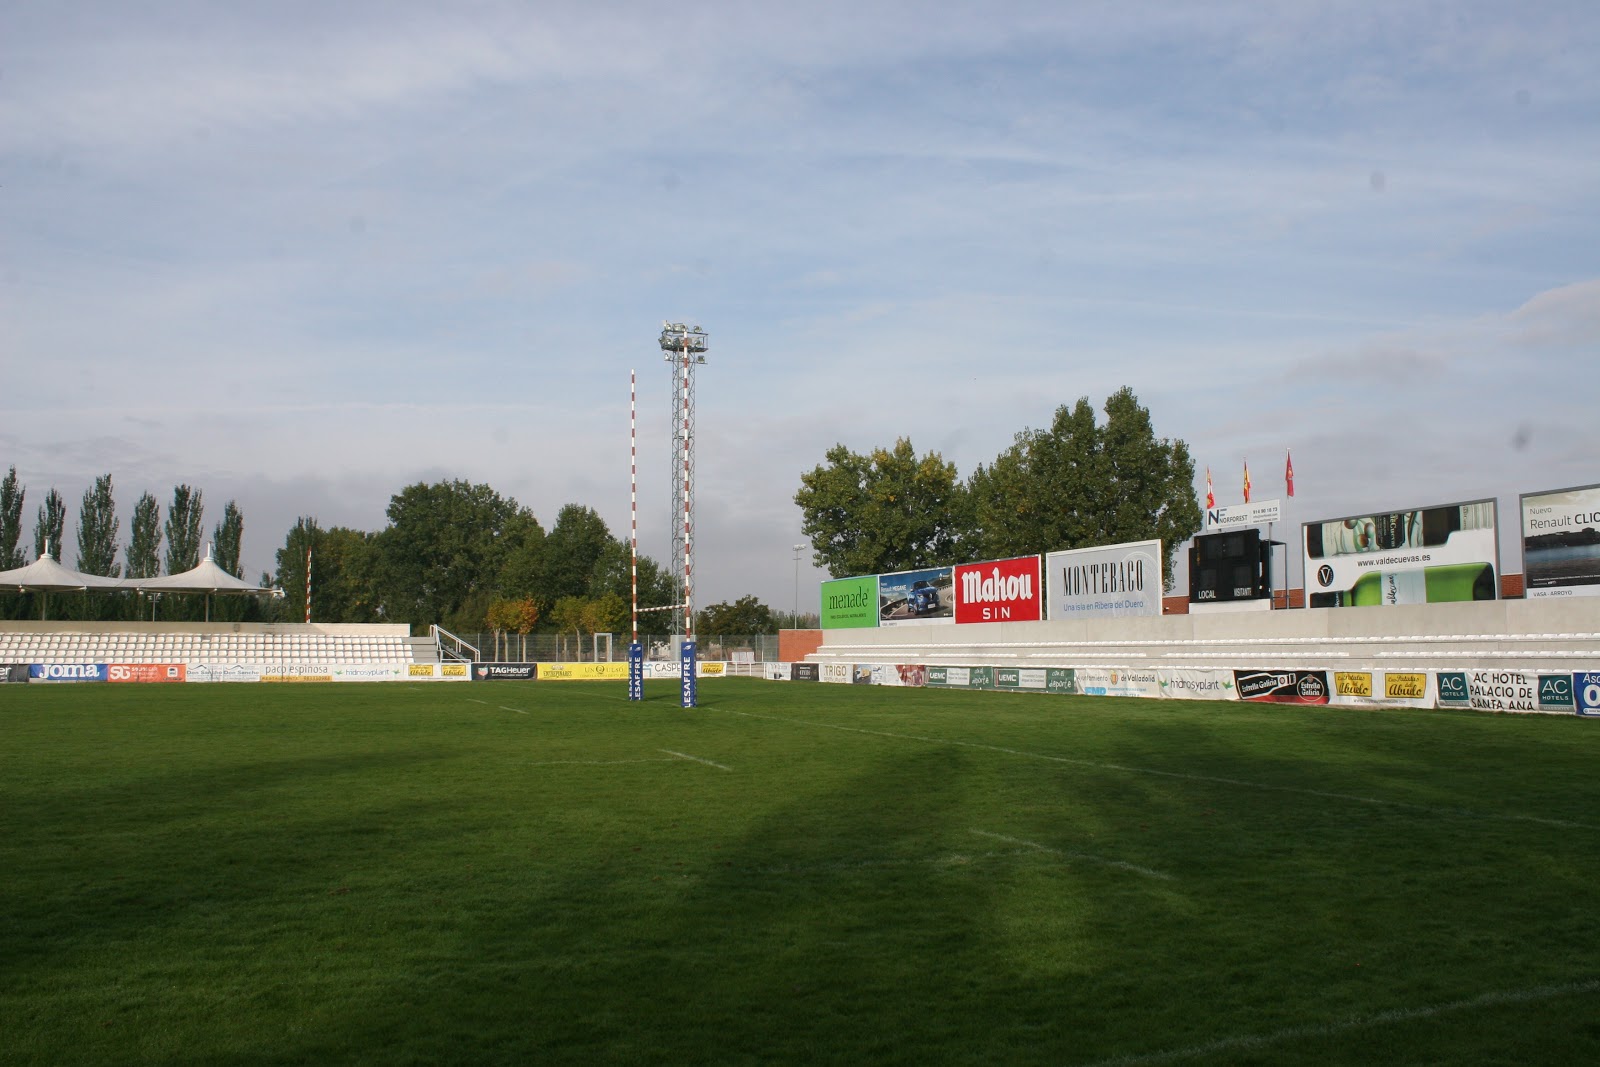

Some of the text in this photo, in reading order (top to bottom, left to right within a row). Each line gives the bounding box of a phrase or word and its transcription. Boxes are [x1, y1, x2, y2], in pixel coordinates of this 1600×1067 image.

[1529, 507, 1552, 515] Nuevo
[1219, 514, 1248, 524] NORFOREST
[1530, 515, 1572, 530] Renault
[1357, 554, 1431, 567] www.valdecuevas.es
[1063, 560, 1143, 597] MONTEBACO
[962, 567, 1033, 604] Mahou
[828, 586, 868, 610] menade
[1198, 590, 1217, 599] LOCAL
[1063, 603, 1075, 612] Una
[1075, 602, 1086, 611] isla
[1094, 601, 1114, 610] Ribera
[1114, 600, 1124, 609] del
[1124, 600, 1144, 608] Duero
[982, 606, 1011, 620] SIN
[265, 664, 328, 676] paco espinosa
[345, 668, 389, 677] hidrosyplant
[683, 656, 691, 708] LESAFFRE
[998, 674, 1017, 682] UEMC
[1120, 674, 1127, 682] de
[1127, 674, 1156, 683] Valladolid
[1441, 677, 1463, 690] AC
[1473, 672, 1528, 685] AC HOTEL
[1048, 679, 1072, 691] deporte
[1170, 678, 1219, 692] hidrosyplant
[1241, 679, 1278, 693] Estrella Galicia
[1339, 683, 1369, 694] Abuelo
[1389, 683, 1422, 696] Abuelo
[1469, 685, 1533, 698] PALACIO DE
[1541, 680, 1568, 694] AC
[1301, 688, 1320, 696] Galicia
[1471, 698, 1534, 711] SANTA ANA
